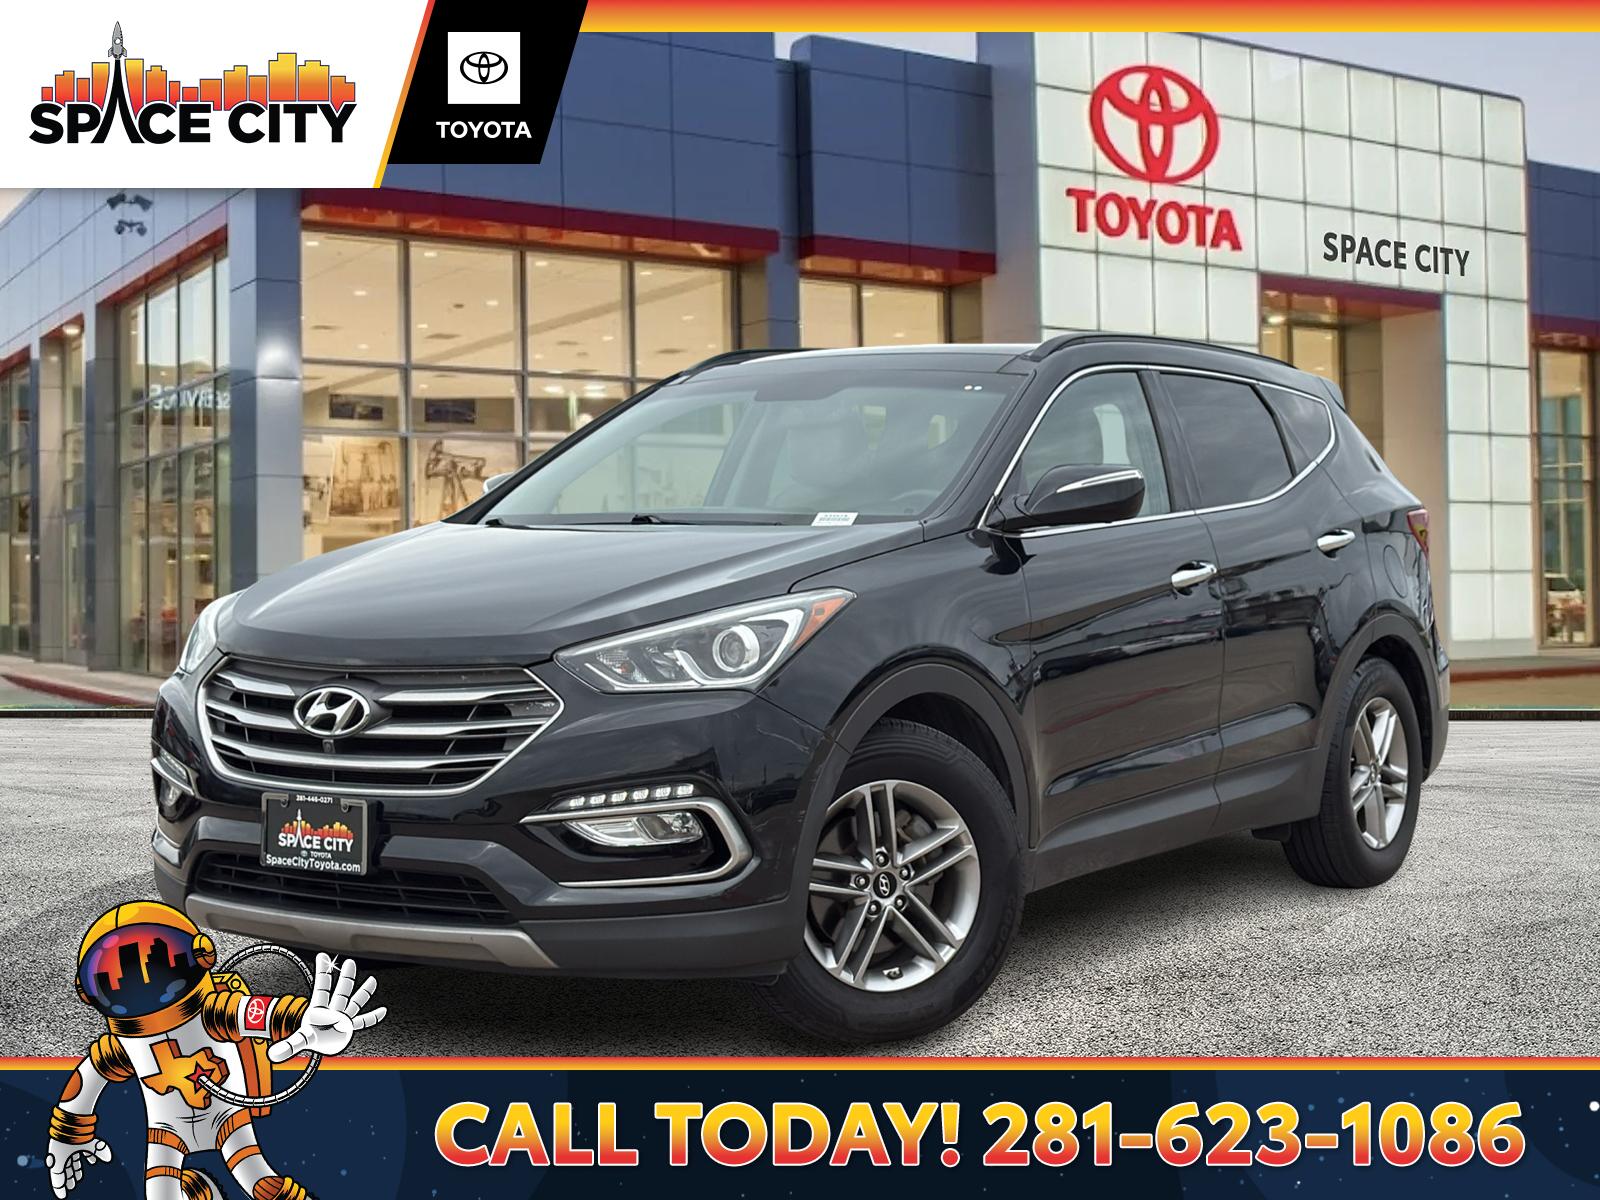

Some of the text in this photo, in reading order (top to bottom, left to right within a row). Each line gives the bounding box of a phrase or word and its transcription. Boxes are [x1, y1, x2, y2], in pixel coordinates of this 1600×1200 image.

[1066, 187, 1243, 252] TOYOTA
[1323, 231, 1471, 277] SPACE CITY
[278, 829, 354, 852] SPACE CITY
[266, 854, 361, 872] SpaceCityToyota.com
[310, 850, 332, 859] TOYOTA
